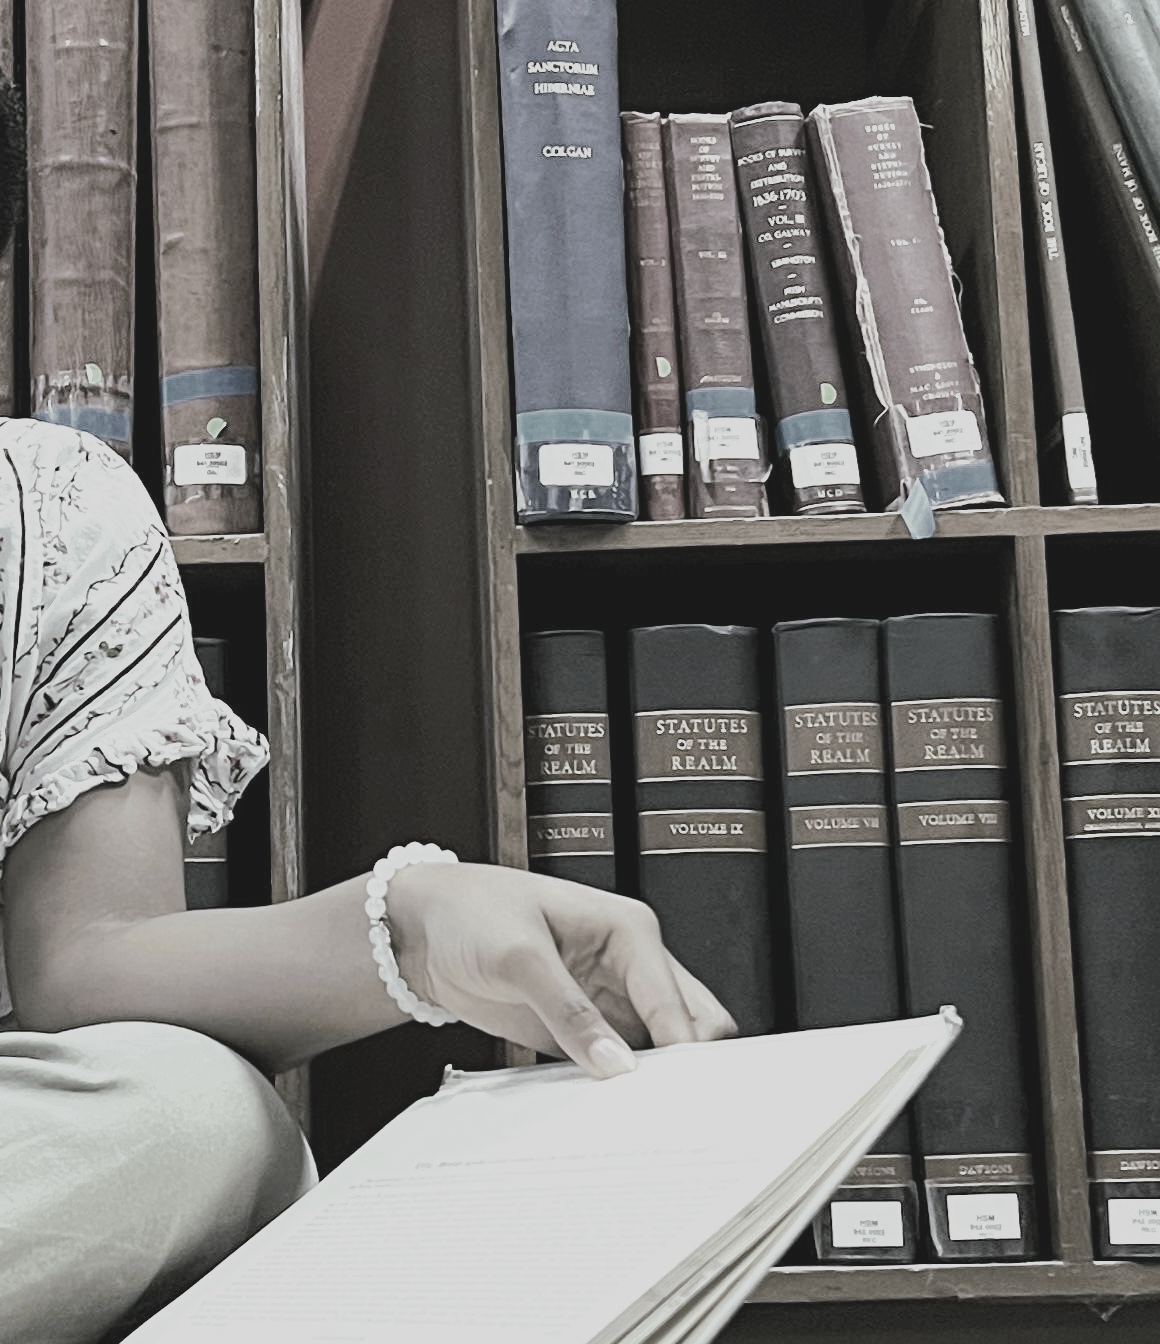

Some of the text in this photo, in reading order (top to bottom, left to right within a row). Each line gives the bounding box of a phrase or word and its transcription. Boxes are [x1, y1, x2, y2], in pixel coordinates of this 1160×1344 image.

[547, 40, 580, 53] ACTA
[527, 60, 600, 76] SANCTORUM
[533, 82, 596, 96] HIBERNIAE
[542, 145, 592, 158] COLGAN
[767, 161, 788, 172] AND
[1033, 142, 1059, 260] THE BOOK OF LECAN
[1132, 196, 1145, 210] OF
[767, 214, 794, 227] VOL.
[773, 228, 811, 240] GALWAY
[1139, 213, 1158, 243] BOOK
[907, 706, 994, 724] STATUTES
[1073, 699, 1160, 717] STATUTES
[655, 718, 748, 735] STATUTES
[794, 711, 879, 728] STATUTES
[527, 721, 605, 739] STATUTES
[929, 726, 978, 740] OF THE
[1094, 721, 1144, 734] OF THE
[676, 738, 728, 751] OF THE
[815, 731, 864, 744] OF THE
[544, 742, 593, 755] OF THE
[923, 744, 985, 760] REALM
[1089, 737, 1151, 754] REALM
[810, 747, 871, 764] REALM
[542, 759, 597, 775] REALM
[671, 755, 738, 772] REALM
[1086, 806, 1145, 820] VOLUME
[803, 817, 860, 830] VOLUME
[918, 815, 976, 827] VOLUME
[536, 825, 606, 839] VOLUME VI
[668, 823, 745, 836] VOLUME IX
[958, 1162, 1013, 1176] DAWSONS
